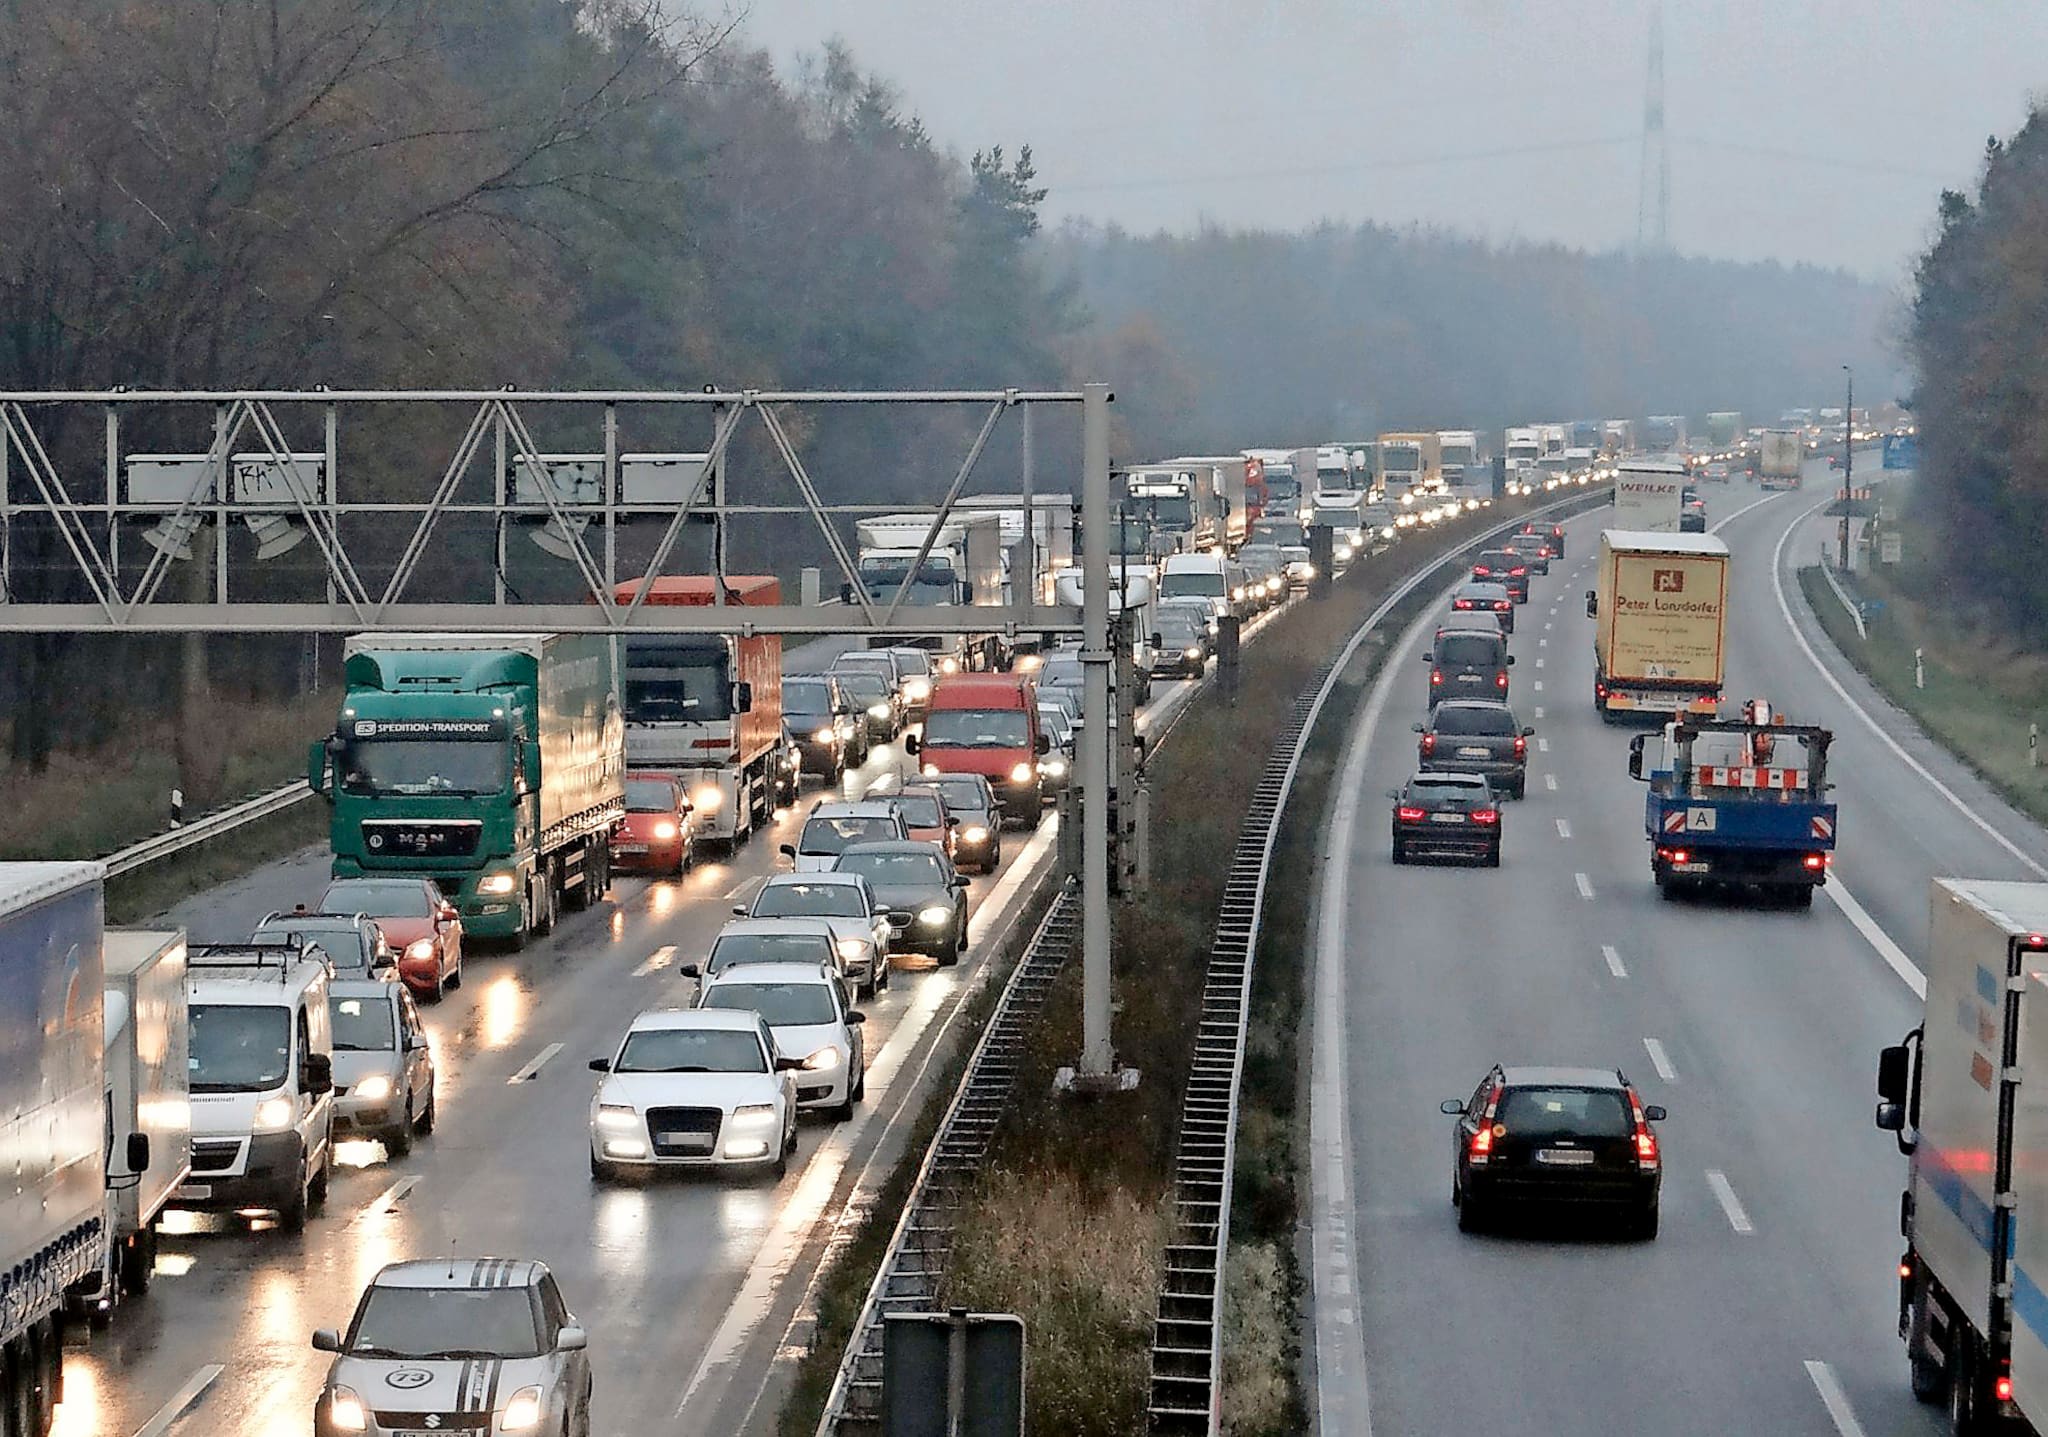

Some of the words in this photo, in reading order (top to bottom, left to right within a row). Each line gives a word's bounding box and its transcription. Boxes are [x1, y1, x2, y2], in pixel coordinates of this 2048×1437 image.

[1617, 596, 1649, 610] Peter
[1650, 666, 1659, 677] A
[377, 723, 490, 732] SPEDITION-TRANSPORT
[1696, 812, 1707, 826] A
[399, 833, 444, 842] MAN
[395, 1373, 425, 1382] 73
